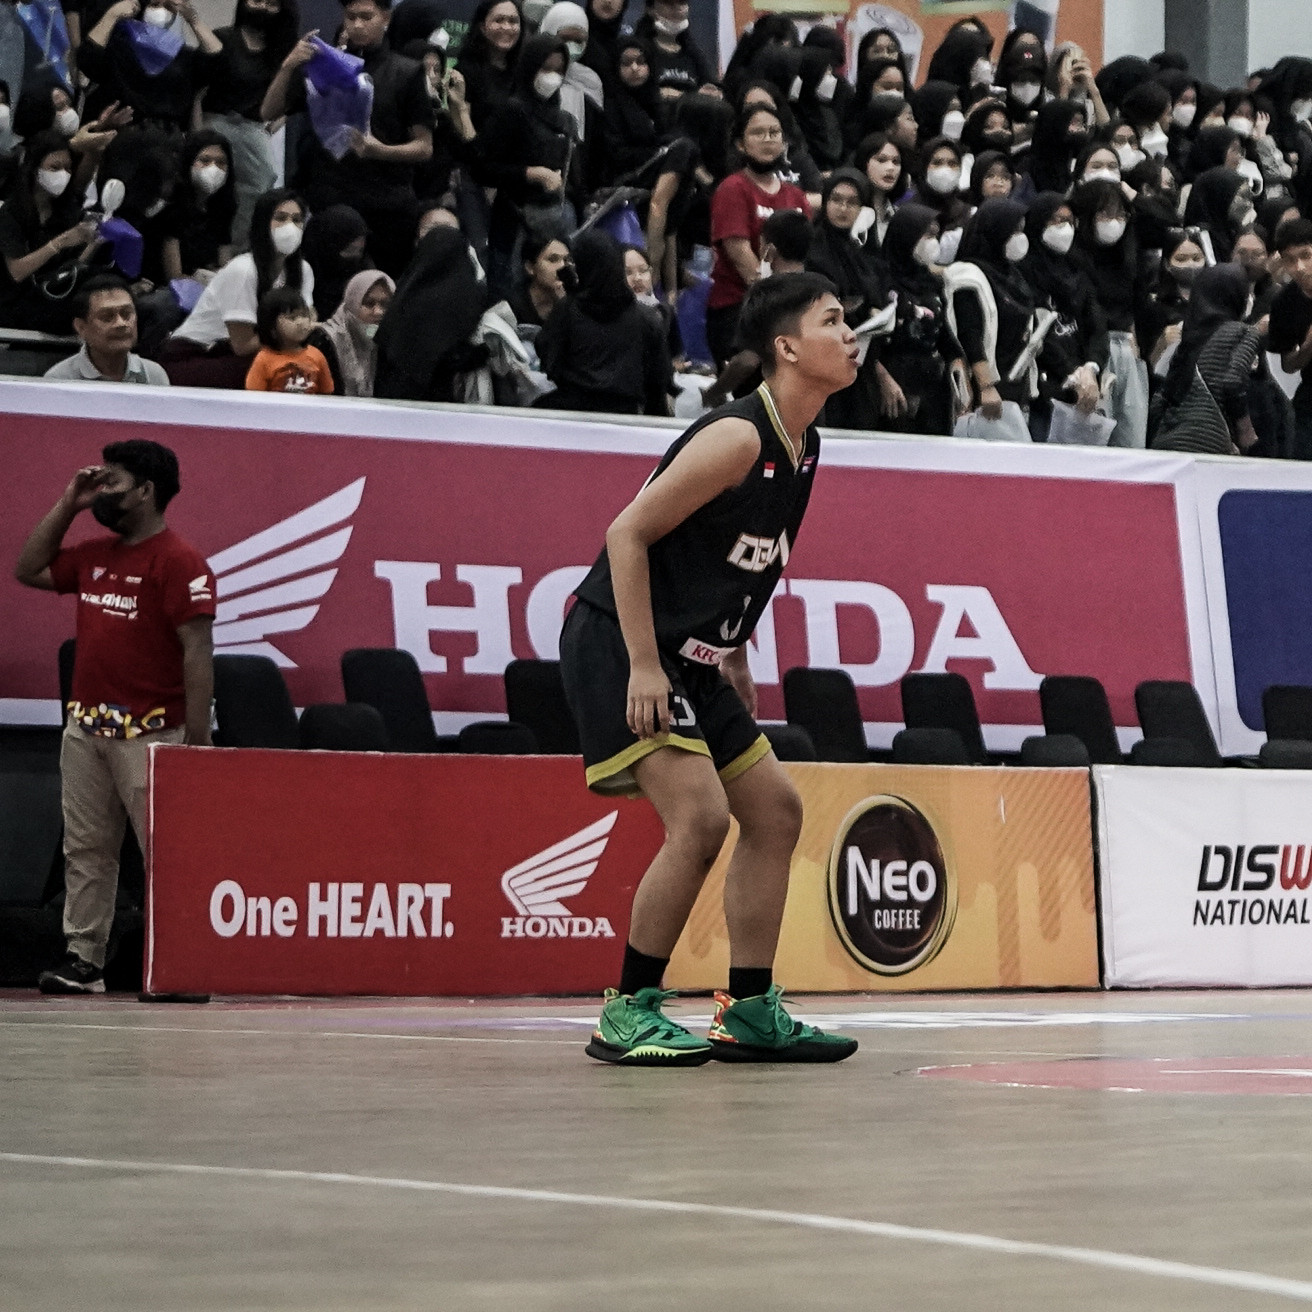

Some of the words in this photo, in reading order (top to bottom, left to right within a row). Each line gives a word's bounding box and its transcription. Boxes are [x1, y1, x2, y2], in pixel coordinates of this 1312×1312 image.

[846, 845, 937, 917] NEO
[209, 879, 298, 938] One
[307, 881, 455, 938] HEART.
[874, 908, 921, 930] COFFEE
[1193, 898, 1311, 927] NATIONAL
[500, 915, 617, 938] HONDA
